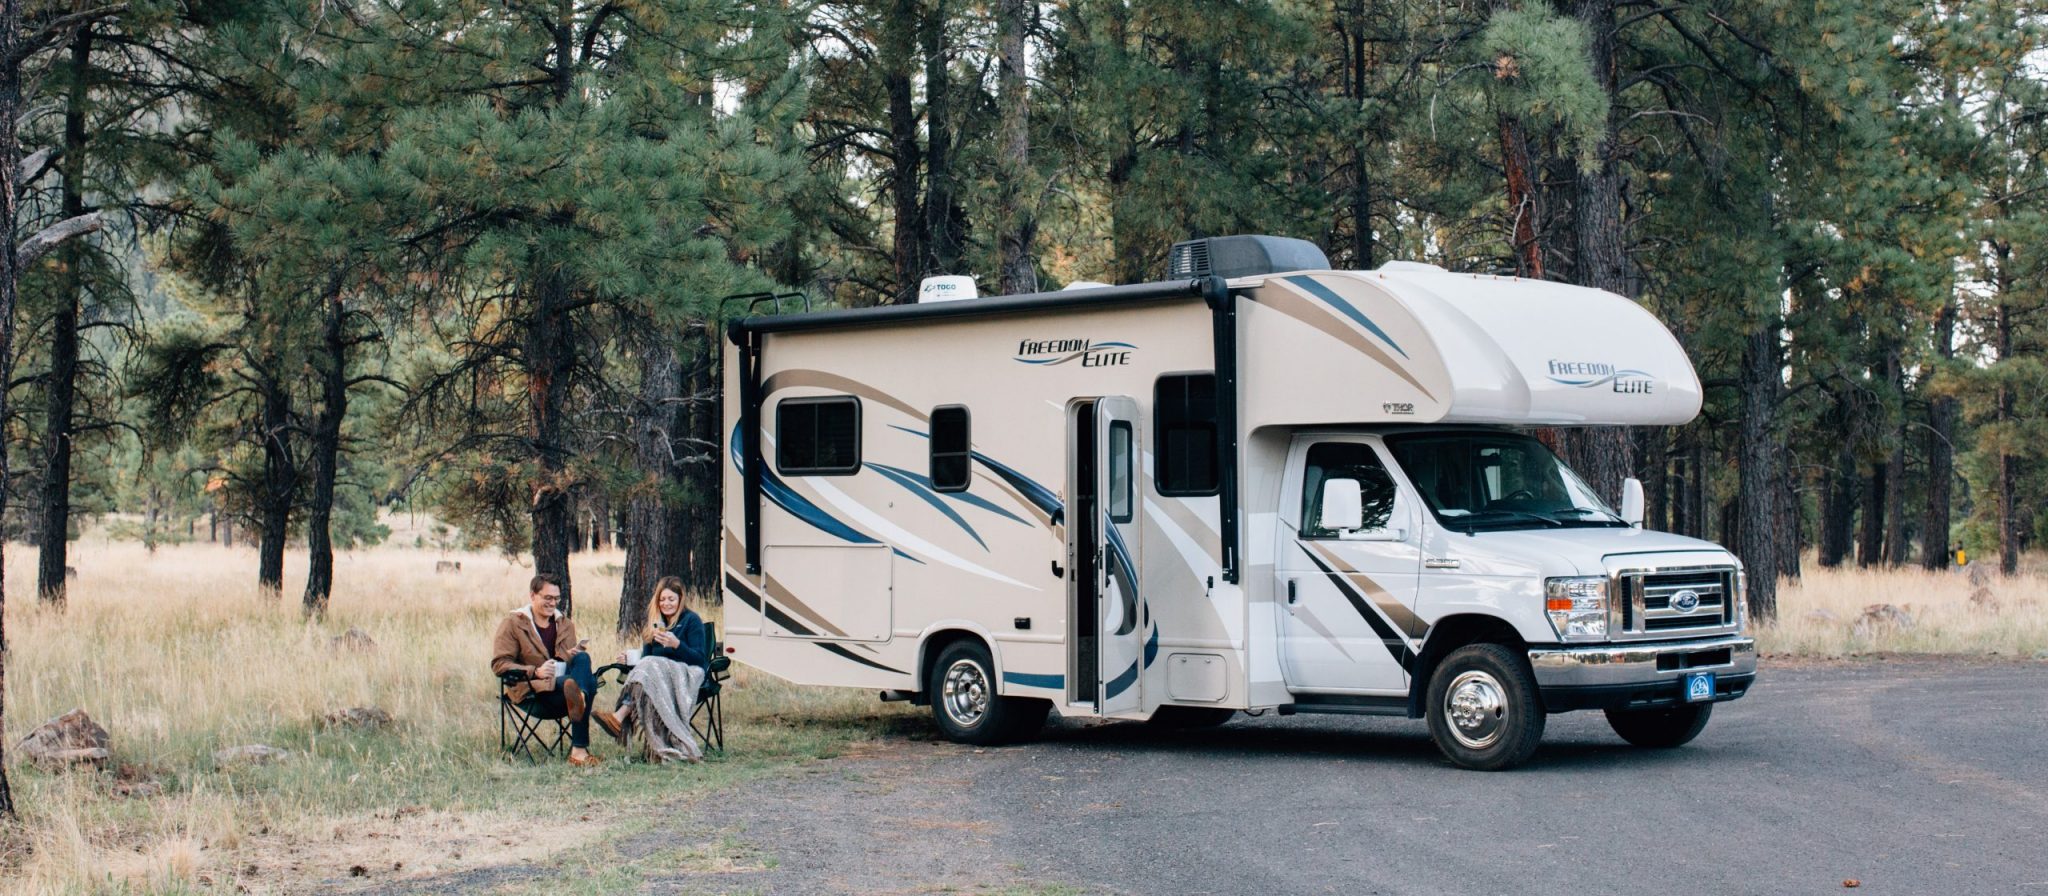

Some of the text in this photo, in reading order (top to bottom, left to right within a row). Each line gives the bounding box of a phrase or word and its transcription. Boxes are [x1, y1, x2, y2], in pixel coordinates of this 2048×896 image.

[1019, 338, 1090, 355] FREEDOM
[1082, 351, 1131, 367] ELITE
[1548, 359, 1616, 376] FREEDOM
[1613, 377, 1654, 394] ELITE
